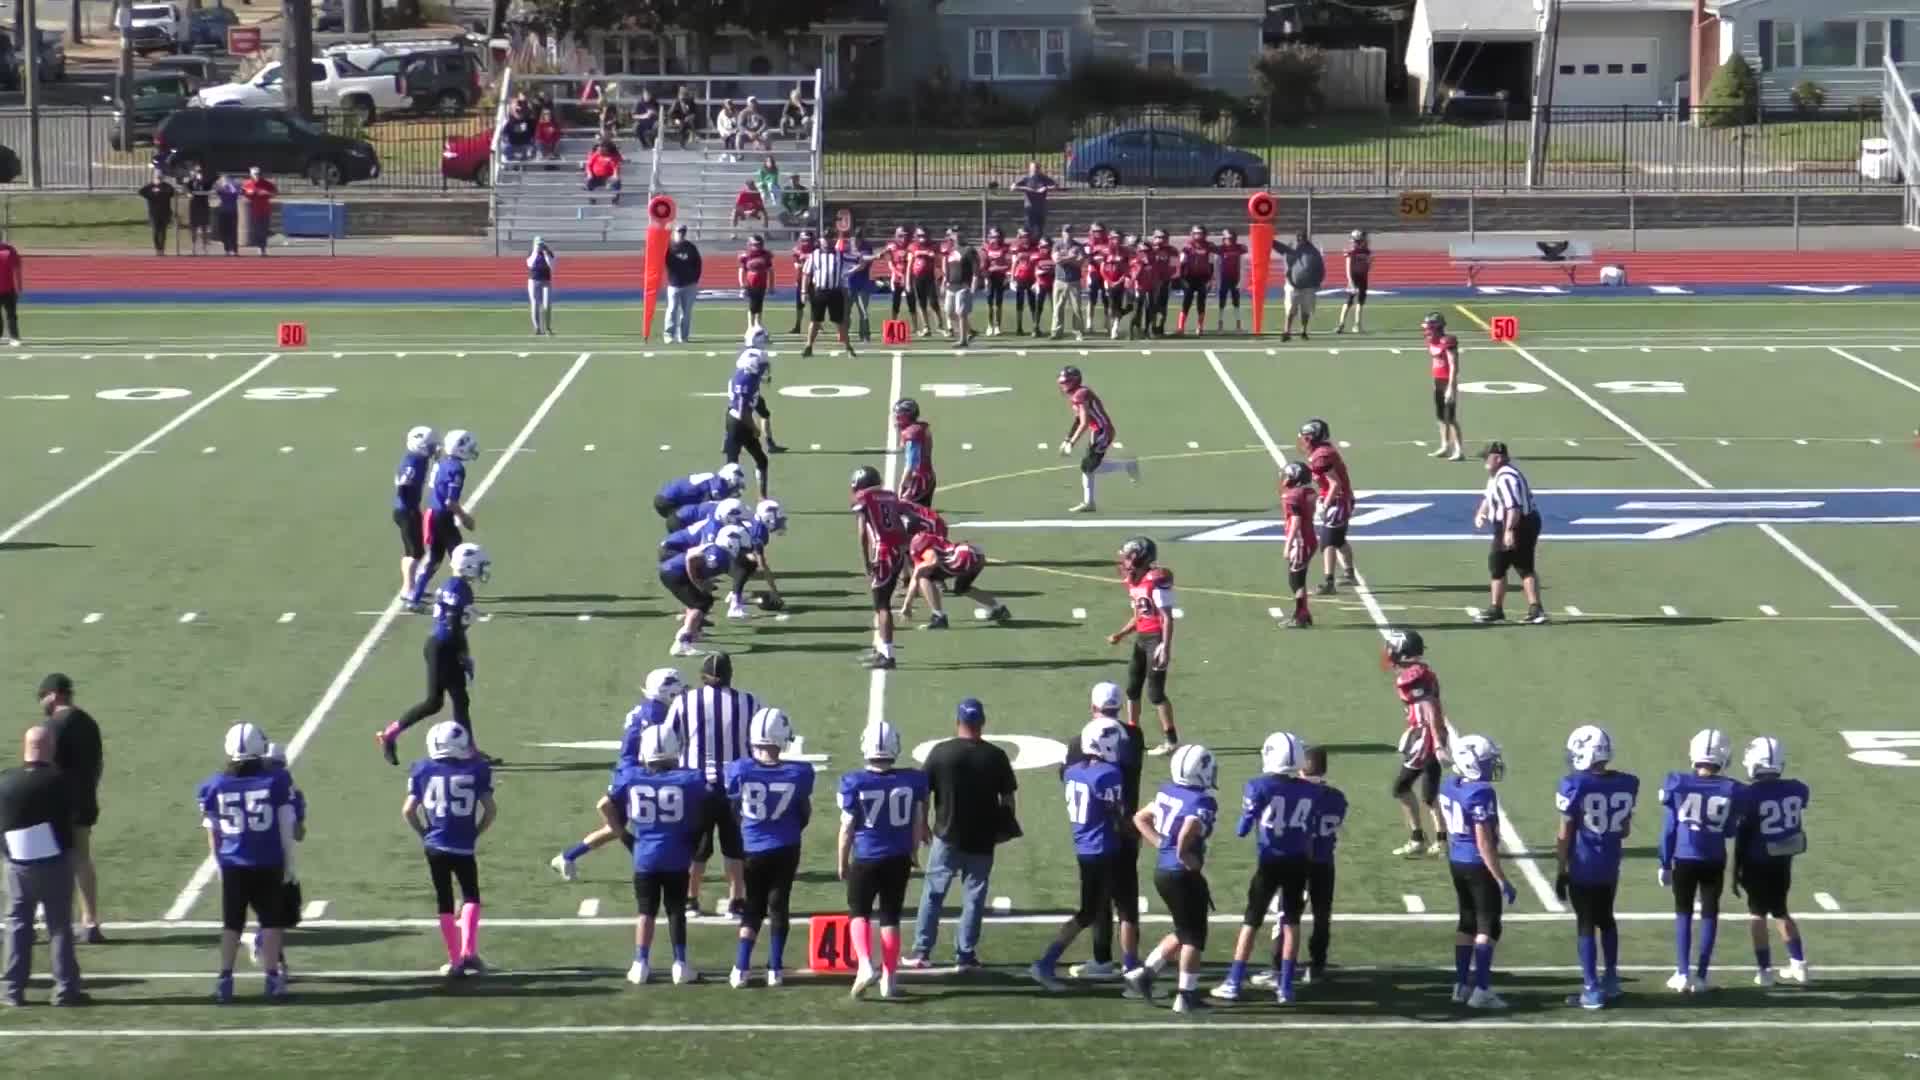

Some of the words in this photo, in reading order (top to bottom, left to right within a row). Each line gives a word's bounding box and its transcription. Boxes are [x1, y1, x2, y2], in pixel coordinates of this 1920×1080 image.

[1401, 198, 1429, 214] 50
[281, 325, 302, 345] 30
[887, 322, 906, 344] 40
[1494, 319, 1514, 338] 50
[217, 789, 274, 833] 55
[423, 774, 475, 817] 45
[627, 785, 685, 824] 69
[740, 782, 796, 821] 87
[858, 786, 914, 828] 70
[1260, 795, 1312, 836] 44
[1583, 792, 1633, 835] 82
[1678, 792, 1731, 833] 49
[1759, 795, 1802, 835] 28
